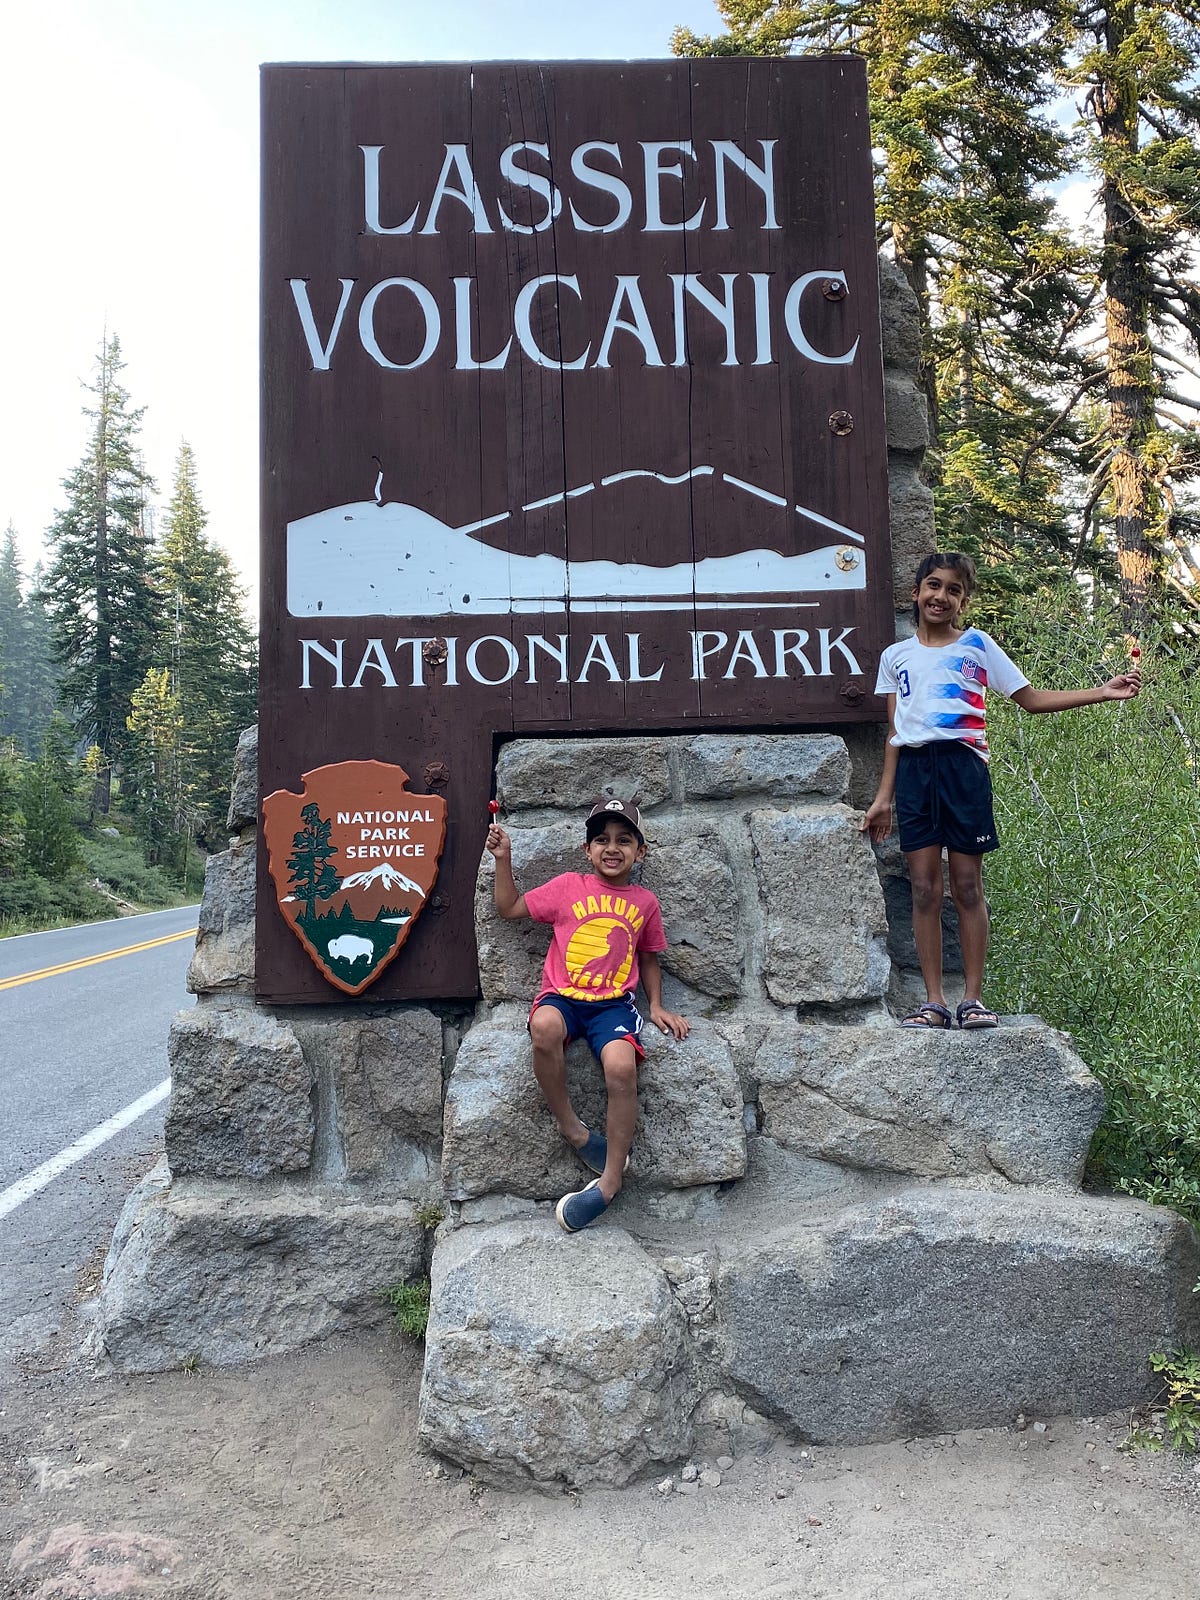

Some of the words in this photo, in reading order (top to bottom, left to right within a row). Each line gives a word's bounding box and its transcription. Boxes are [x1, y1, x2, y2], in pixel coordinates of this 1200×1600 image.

[358, 138, 783, 235] LASSEN
[288, 269, 860, 370] VOLCANIC
[298, 632, 665, 689] NATIONAL
[689, 626, 865, 680] PARK
[336, 809, 435, 825] NATIONAL
[360, 827, 411, 841] PARK
[346, 843, 425, 859] SERVICE
[571, 894, 645, 933] HAKUNA
